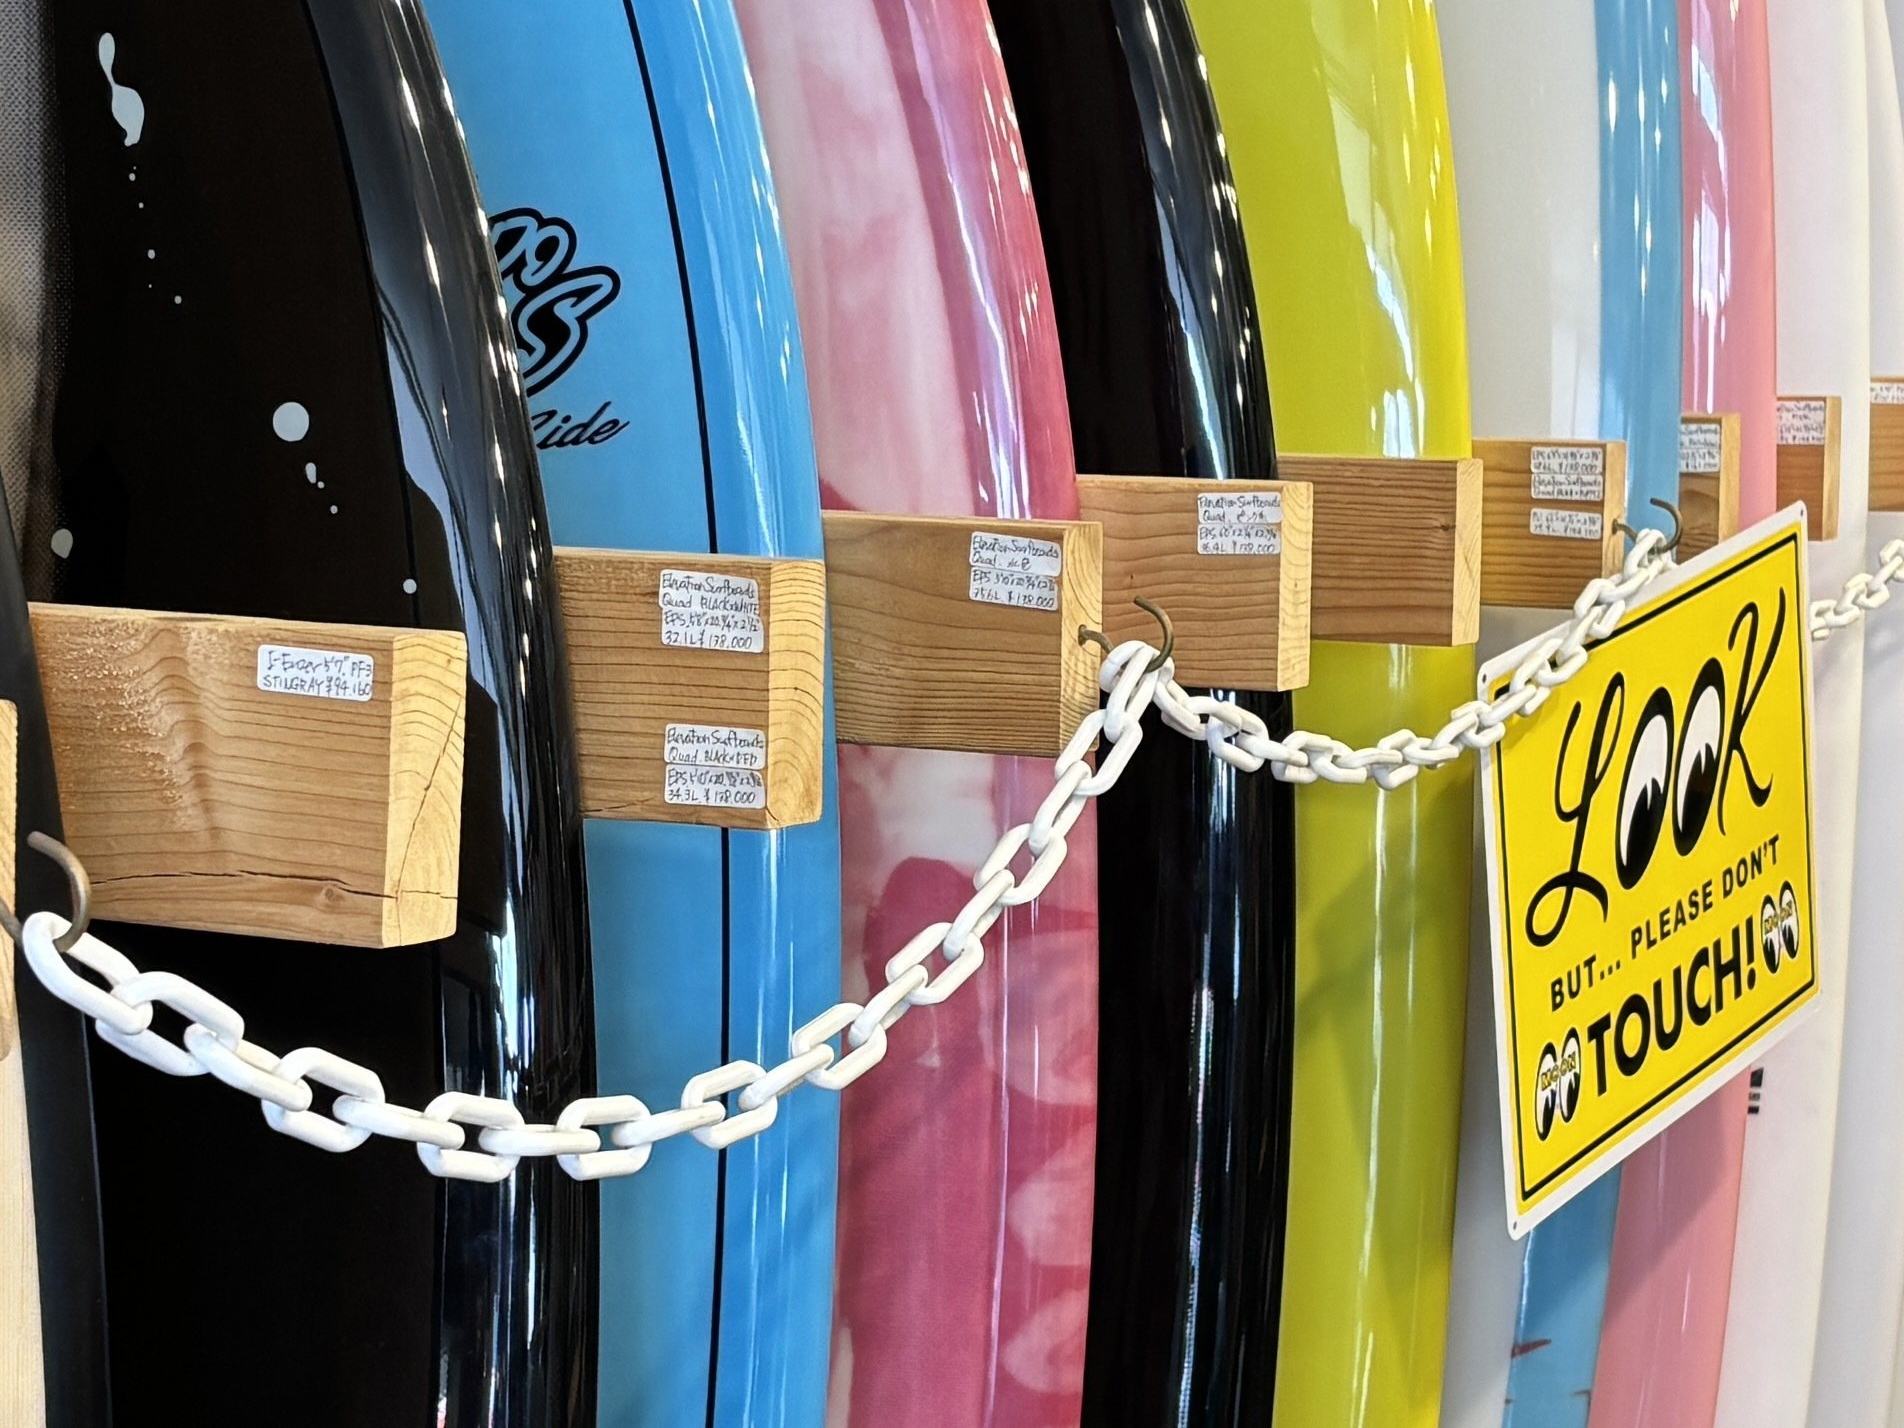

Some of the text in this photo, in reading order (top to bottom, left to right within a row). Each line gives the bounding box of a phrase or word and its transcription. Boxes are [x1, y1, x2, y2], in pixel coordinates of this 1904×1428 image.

[1524, 586, 1787, 948] LOOK
[1550, 833, 1780, 1013] BUT... PLEASE DON'T
[1539, 1050, 1578, 1091] MOON
[1587, 925, 1758, 1099] TOUCH!
